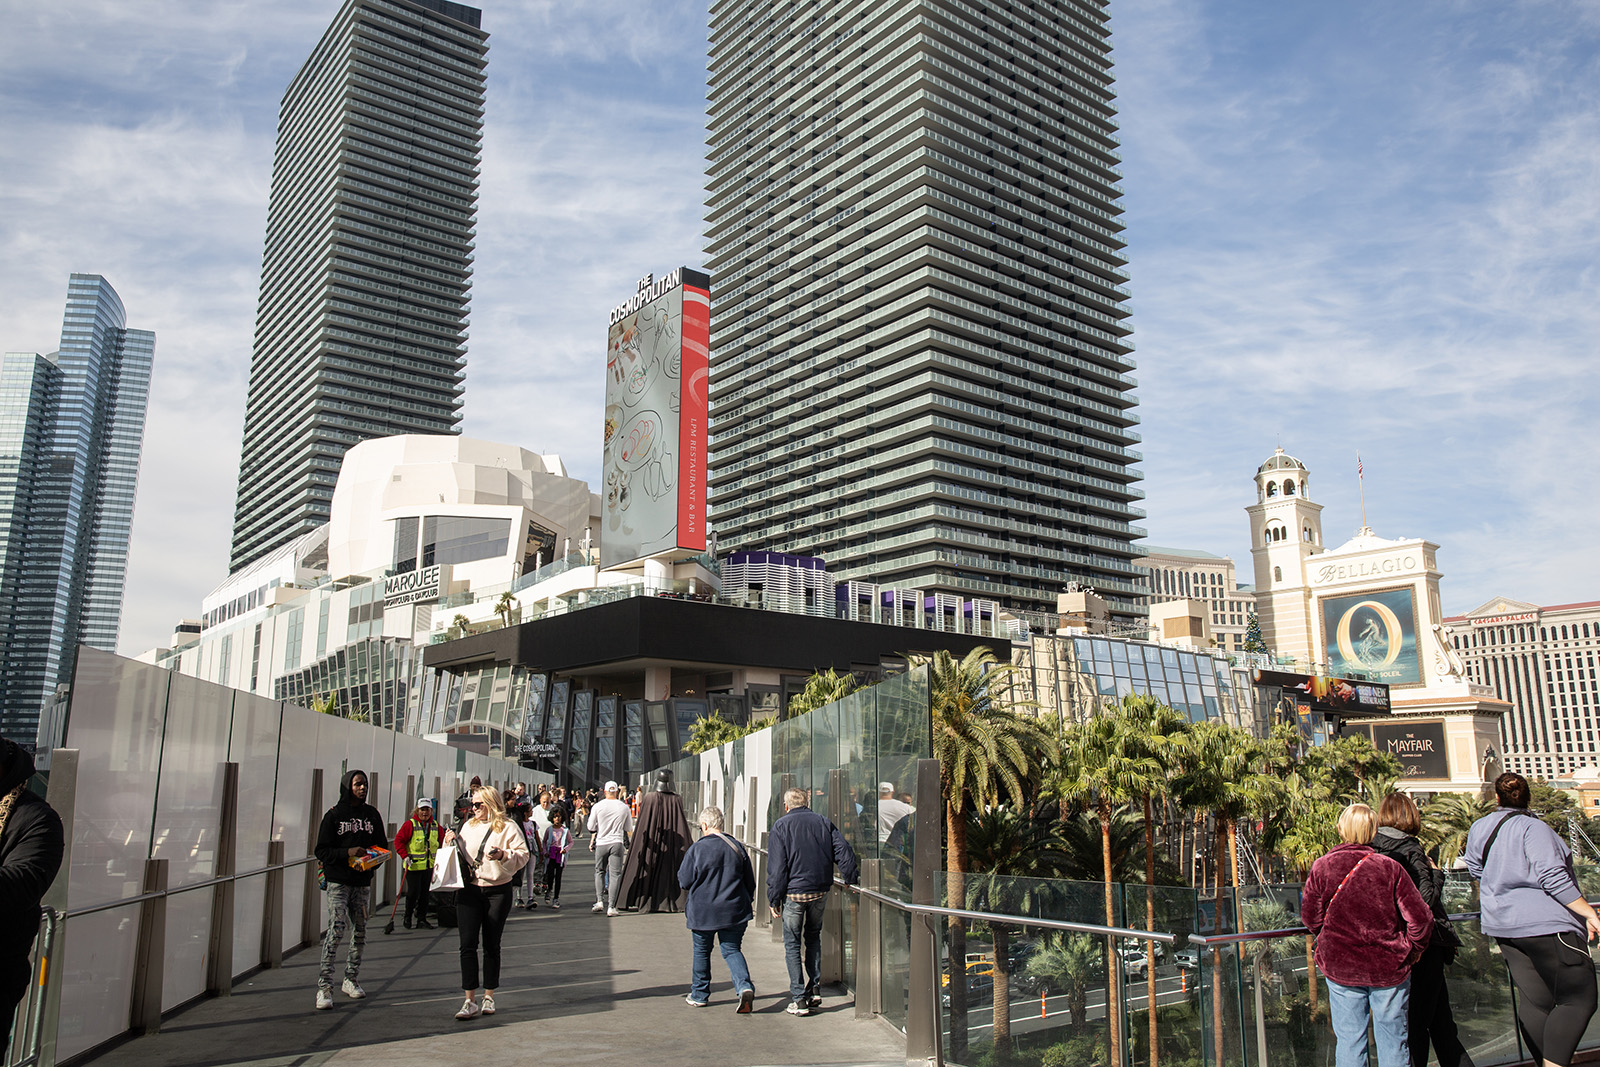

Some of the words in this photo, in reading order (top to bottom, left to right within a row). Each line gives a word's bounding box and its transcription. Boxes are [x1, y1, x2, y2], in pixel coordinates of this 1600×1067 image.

[636, 273, 653, 291] THE
[609, 267, 681, 326] COSMOPOLITAN
[689, 440, 697, 505] RESTAURANT
[688, 503, 696, 511] &
[1314, 556, 1416, 584] BELLAGIO
[384, 566, 440, 595] MARQUEE
[1473, 616, 1504, 625] CAESARS
[1506, 613, 1534, 622] PALACE
[1372, 686, 1387, 698] NEW
[523, 743, 556, 753] COSMOPOLITAN
[1387, 739, 1435, 753] MAYFAIR
